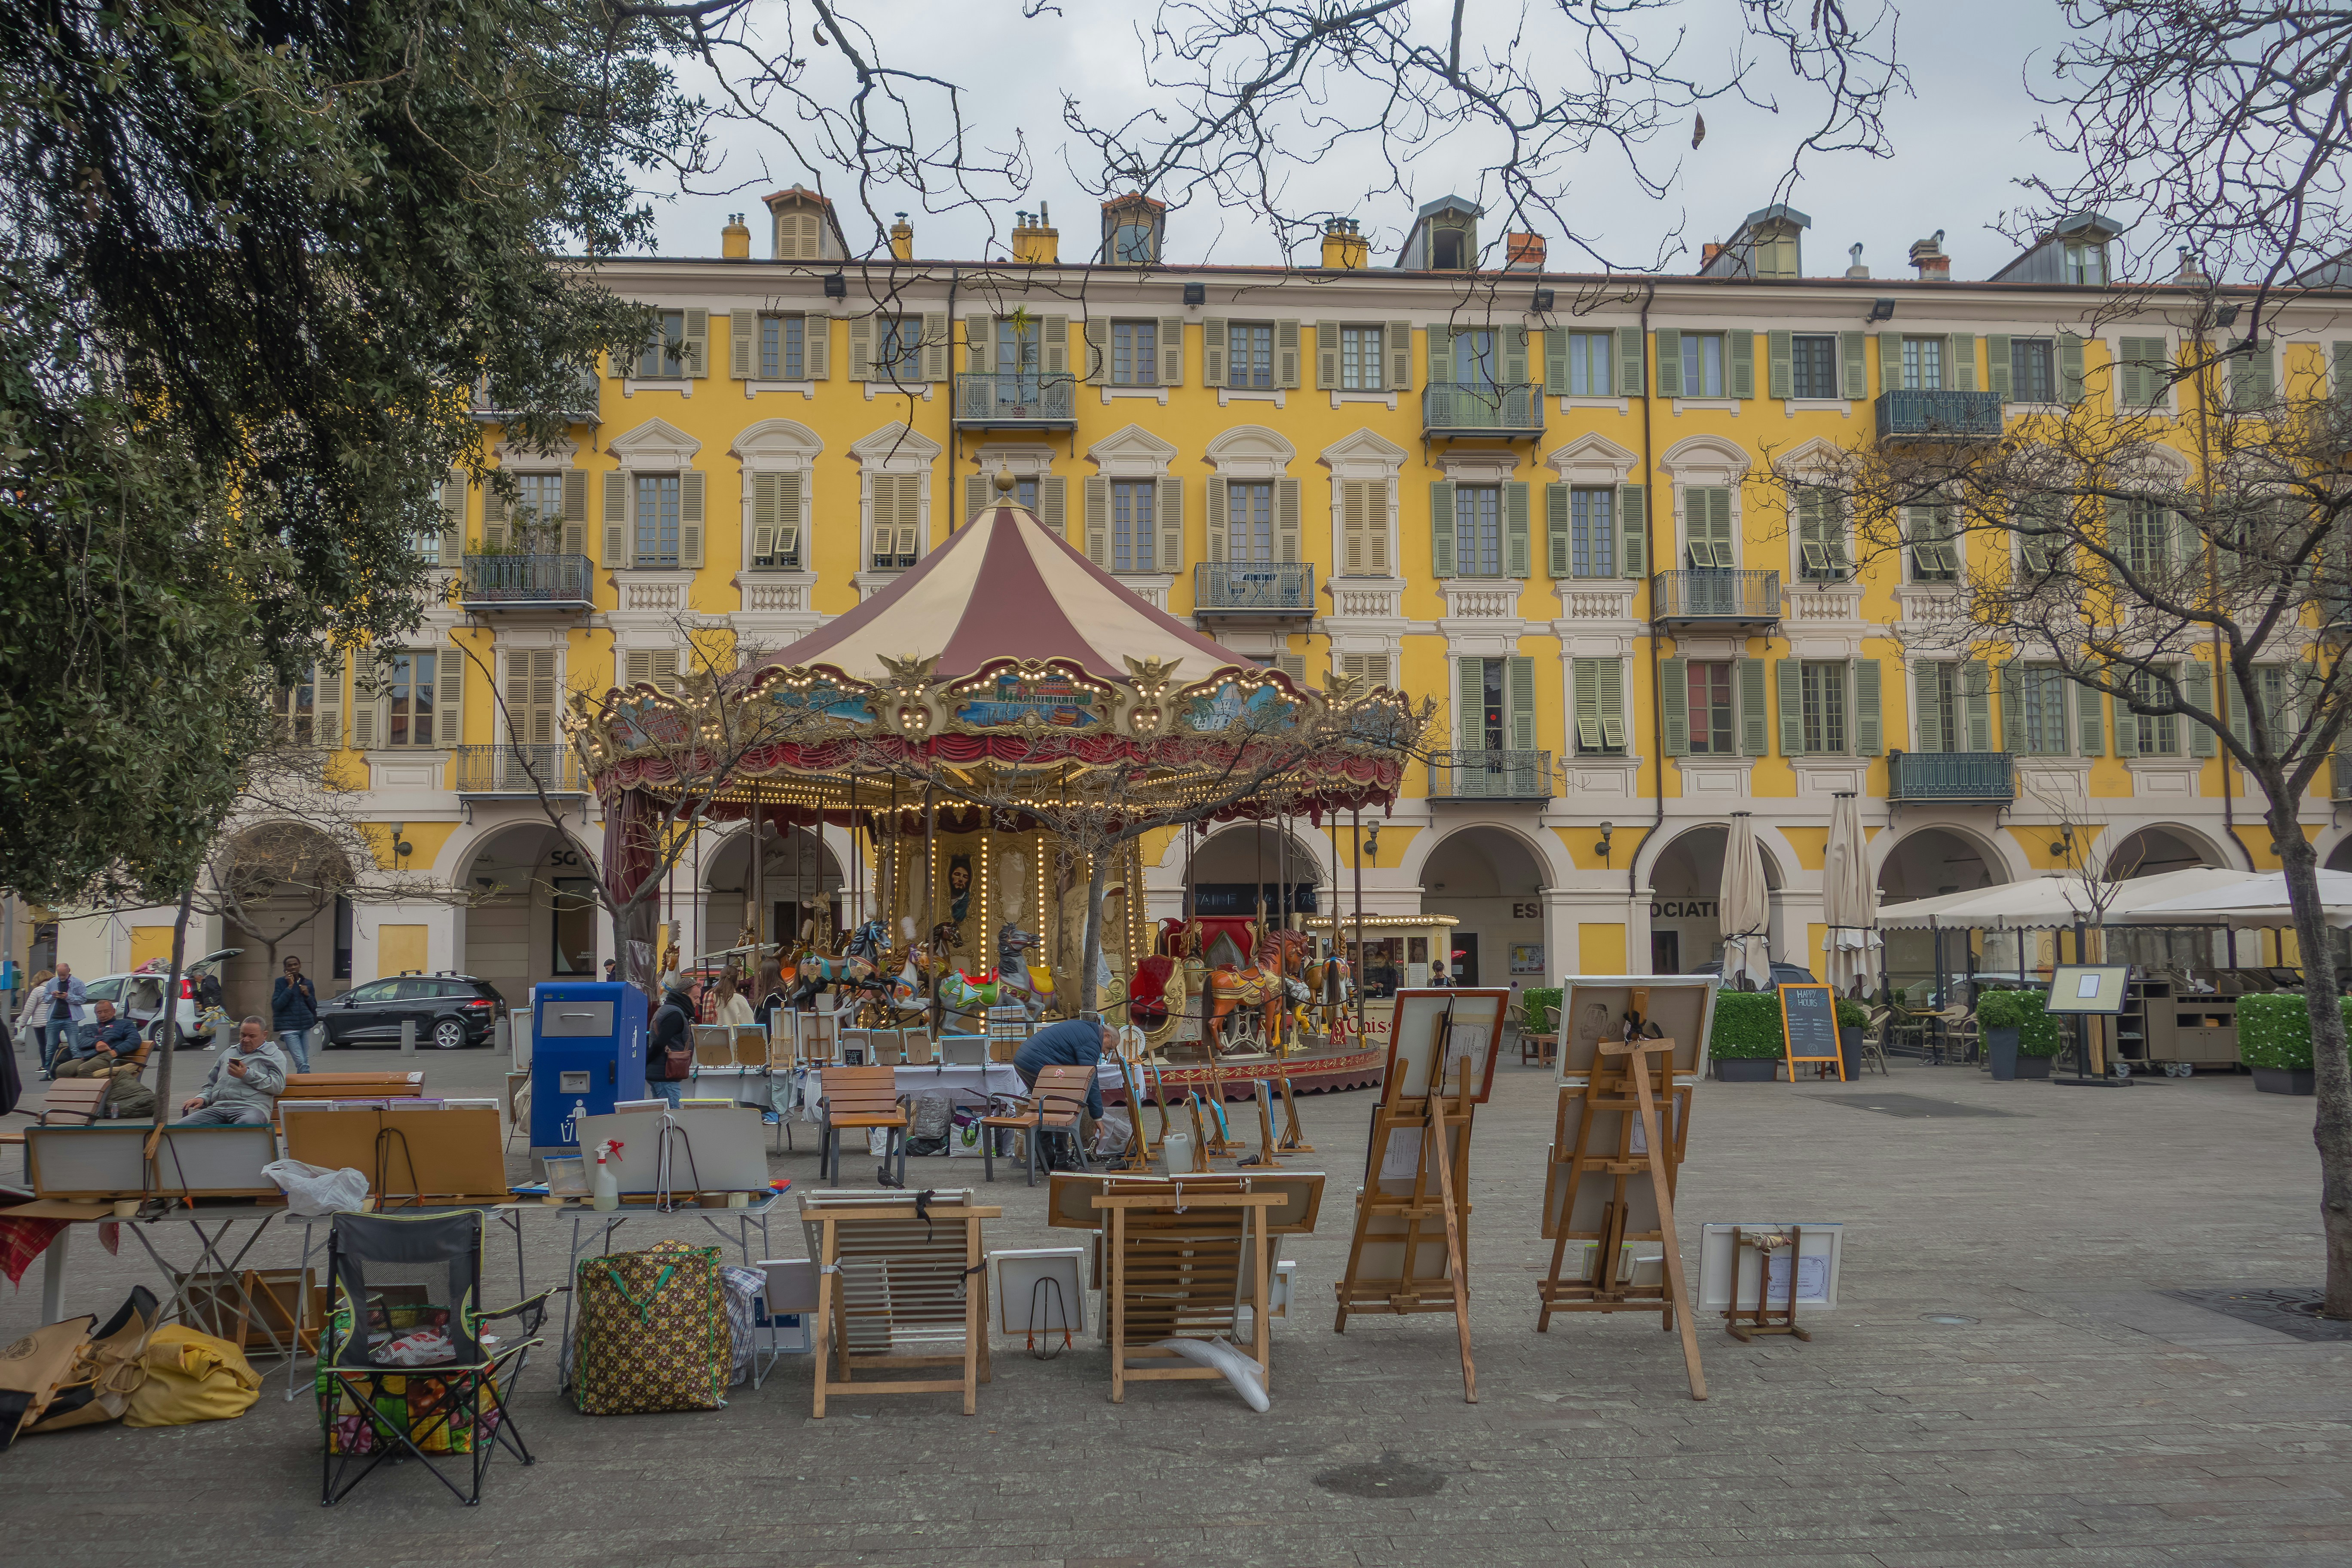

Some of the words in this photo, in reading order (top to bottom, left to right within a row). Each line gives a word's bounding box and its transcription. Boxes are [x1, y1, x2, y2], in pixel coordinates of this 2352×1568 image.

[551, 851, 577, 866] SG
[1183, 894, 1237, 906] TAIRE
[1797, 989, 1817, 998] HAPPY
[1798, 999, 1818, 1007] HOURS
